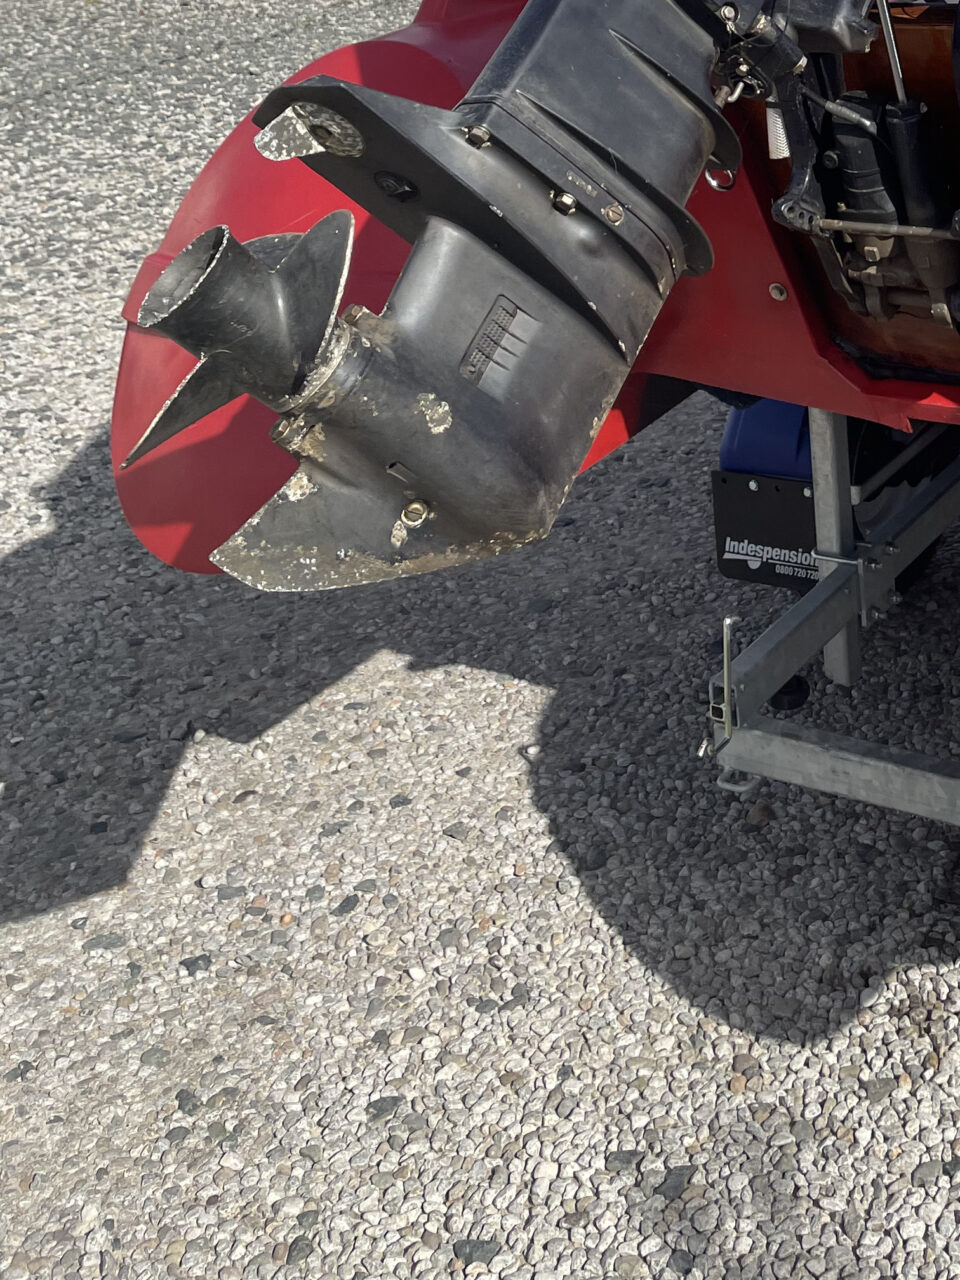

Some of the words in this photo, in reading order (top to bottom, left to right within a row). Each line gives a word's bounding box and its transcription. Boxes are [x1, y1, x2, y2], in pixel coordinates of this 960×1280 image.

[725, 536, 820, 567] Indespension
[775, 564, 793, 576] 0800
[794, 567, 807, 578] 720
